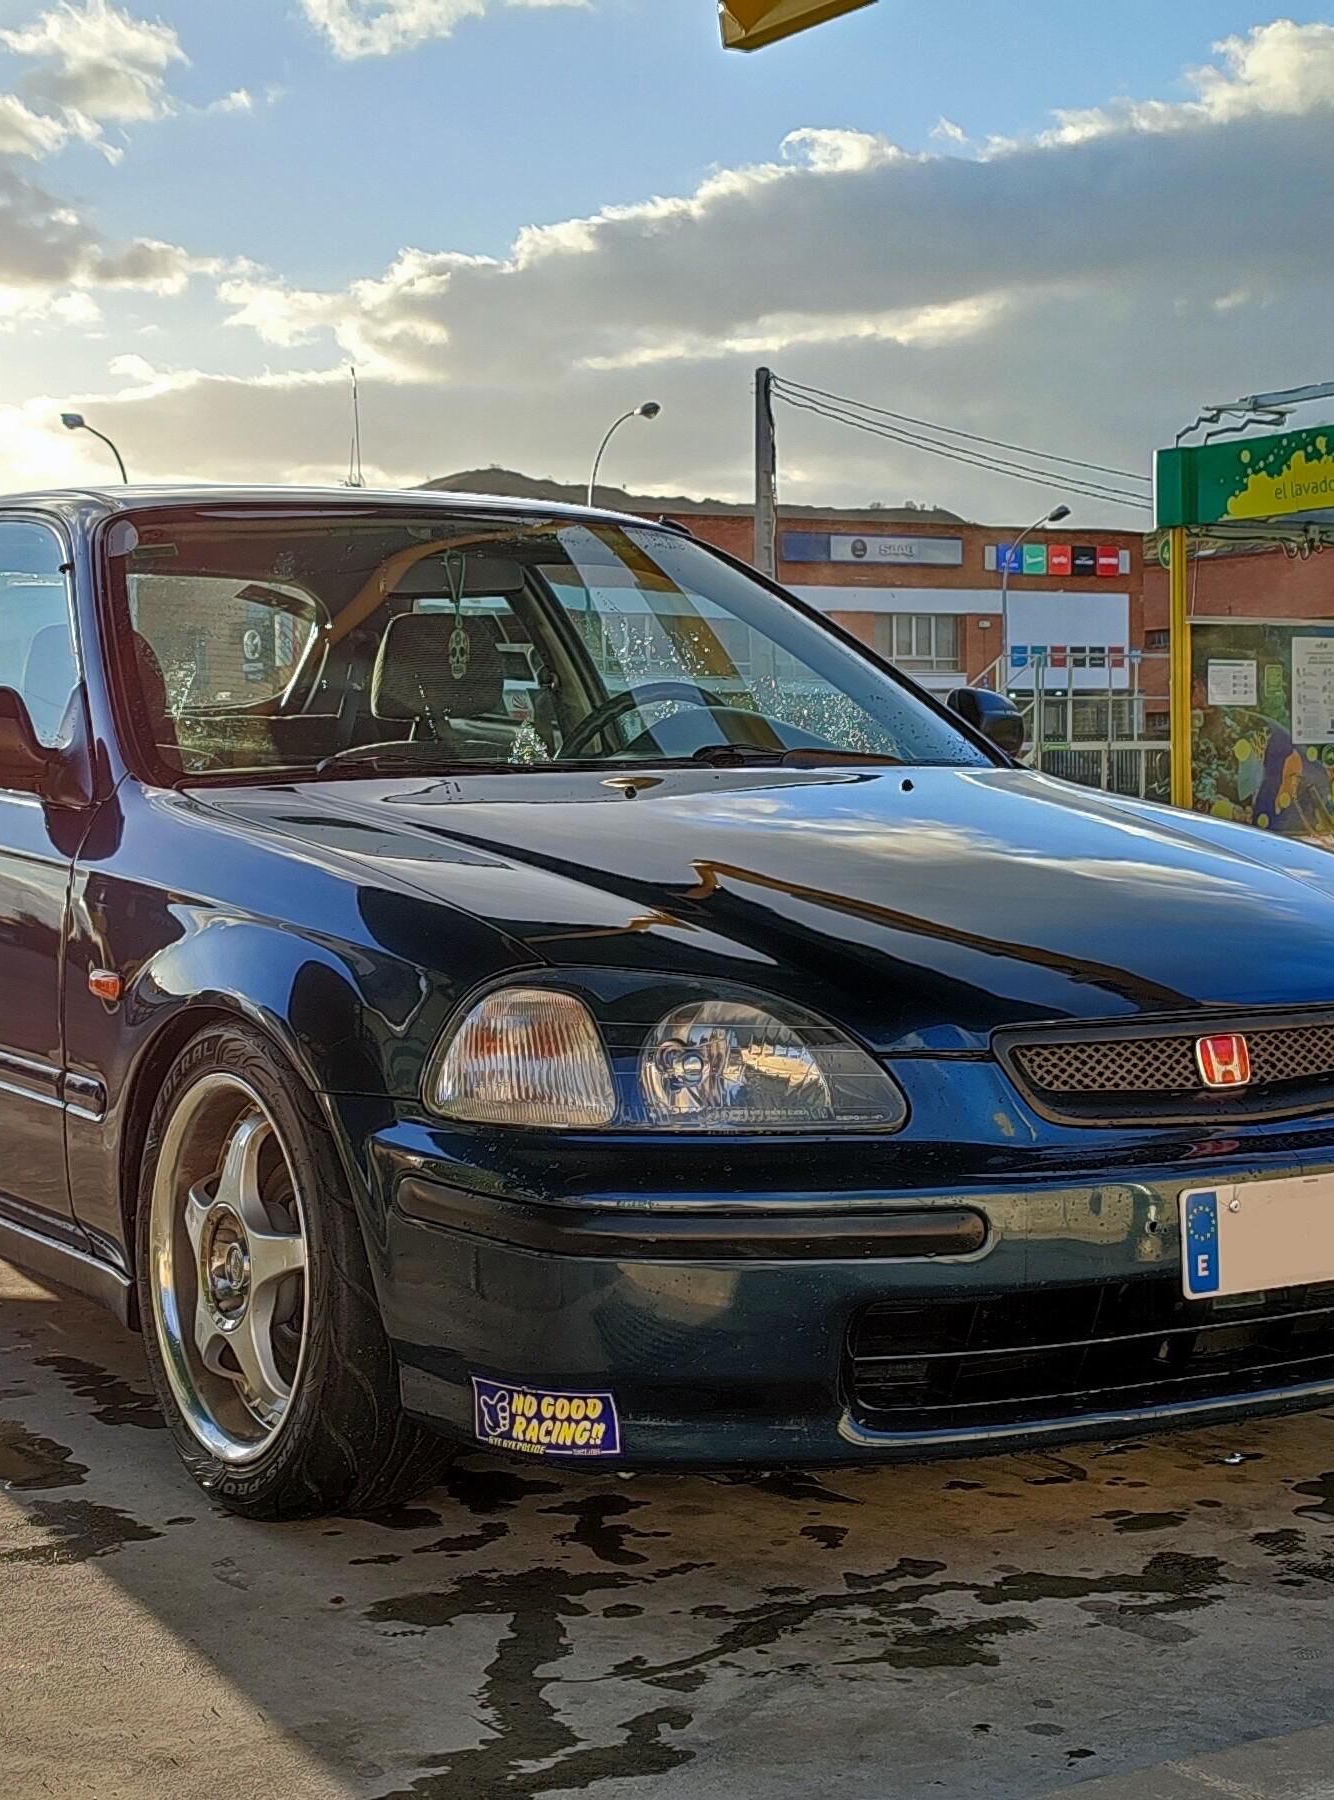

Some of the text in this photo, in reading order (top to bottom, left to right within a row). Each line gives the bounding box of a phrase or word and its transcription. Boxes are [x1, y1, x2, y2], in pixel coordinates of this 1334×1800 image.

[1274, 483, 1287, 500] el
[1197, 1254, 1210, 1277] E
[511, 1392, 603, 1420] NO GOOD
[512, 1415, 606, 1446] RACING!!
